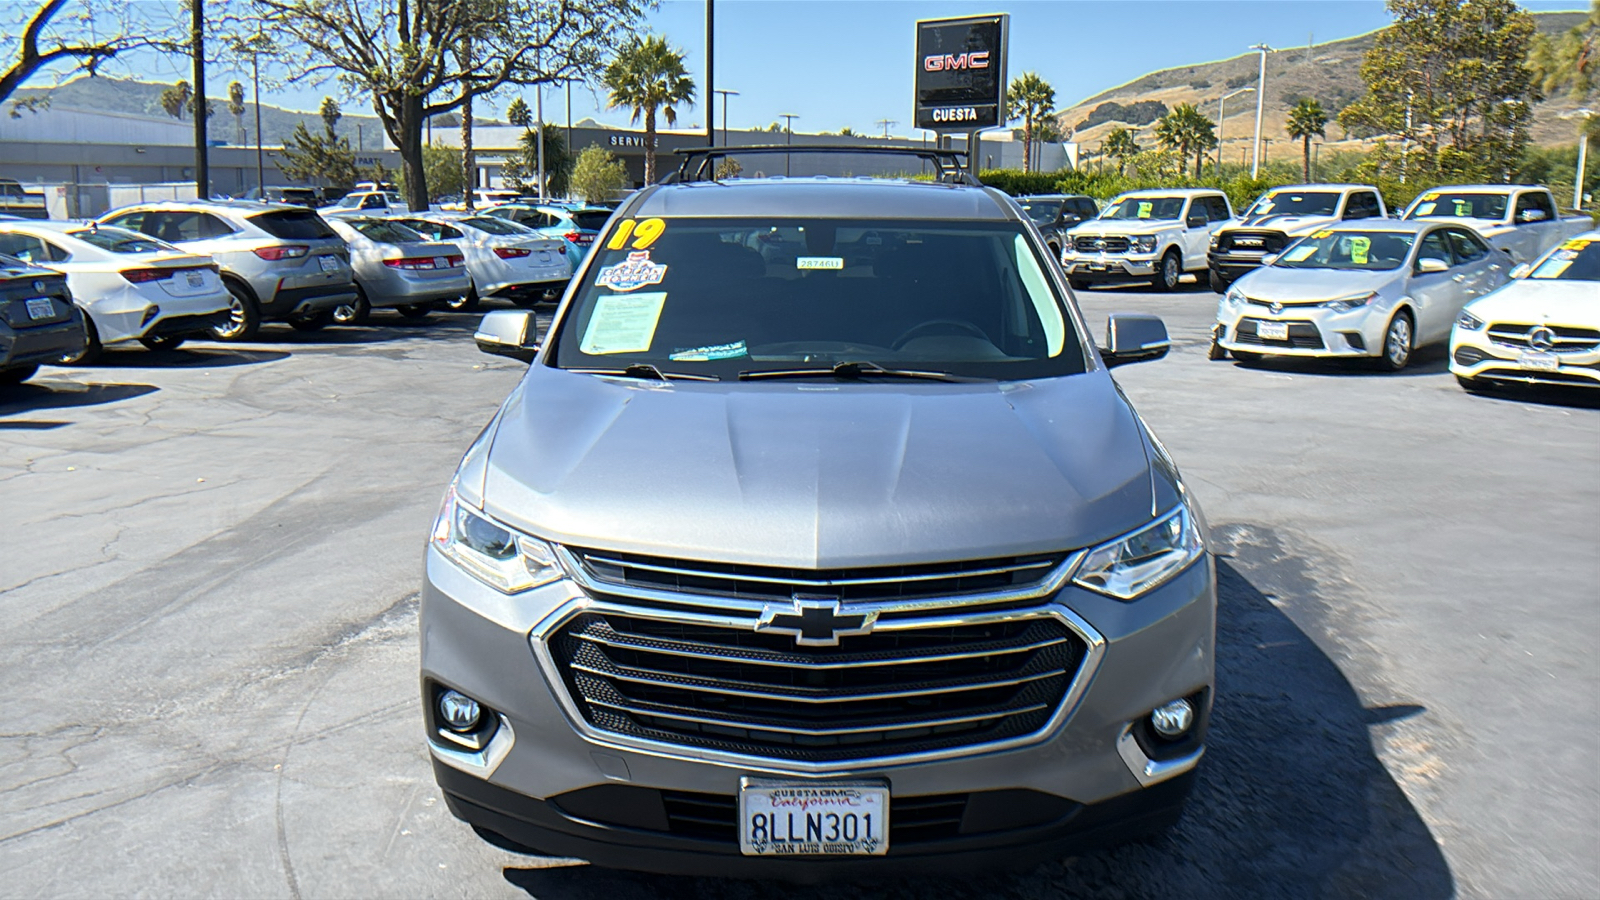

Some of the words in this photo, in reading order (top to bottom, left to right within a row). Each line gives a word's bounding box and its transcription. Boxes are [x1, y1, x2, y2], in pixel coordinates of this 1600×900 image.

[925, 51, 989, 71] GMC
[933, 108, 977, 122] CUESTA
[611, 136, 658, 147] SERVIE
[607, 219, 666, 250] 19
[771, 797, 860, 811] California
[751, 813, 871, 842] 8LLN301
[775, 843, 794, 853] SAN
[799, 844, 819, 853] LUIS
